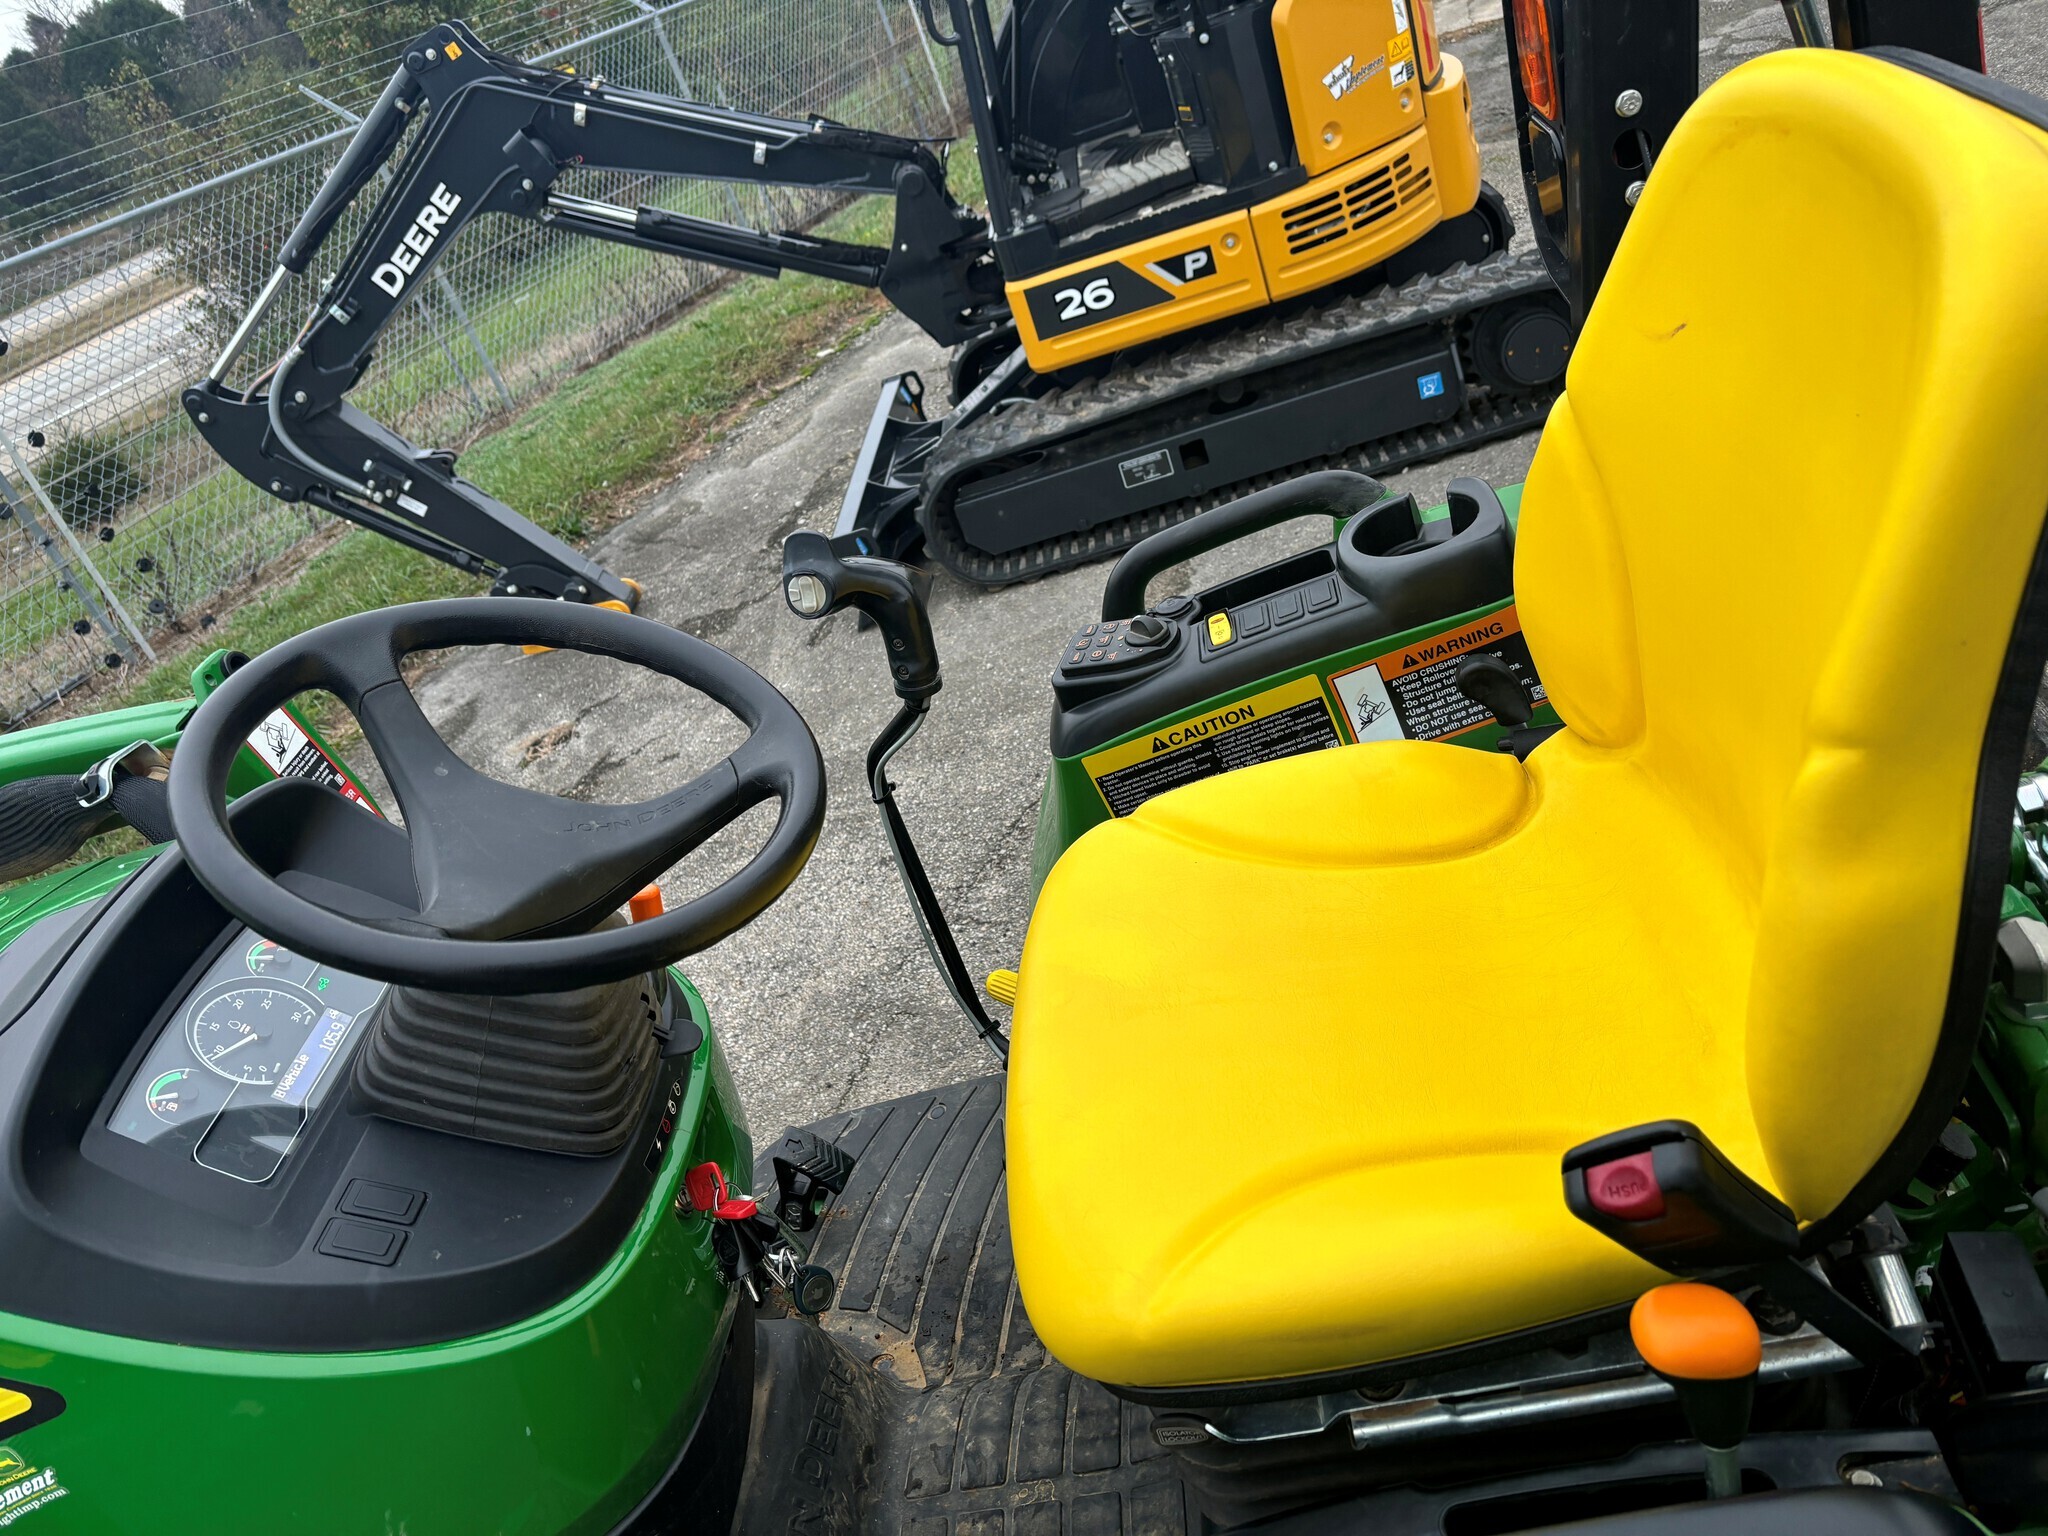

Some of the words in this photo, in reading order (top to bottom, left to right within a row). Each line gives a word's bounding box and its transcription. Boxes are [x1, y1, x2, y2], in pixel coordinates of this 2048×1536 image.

[371, 182, 461, 298] DEERE
[1055, 278, 1115, 321] 26
[1184, 251, 1208, 280] P
[1418, 622, 1504, 662] WARNING
[1390, 672, 1418, 687] AVOID
[1399, 679, 1422, 693] Keep
[1422, 666, 1457, 684] Rollover
[1402, 681, 1442, 700] Structure
[1442, 675, 1457, 686] full
[1405, 698, 1418, 708] Do
[1419, 692, 1434, 703] not
[1434, 684, 1457, 699] jump
[1408, 705, 1425, 716] Use
[1426, 698, 1445, 709] seat
[1169, 705, 1255, 745] CAUTION
[1235, 723, 1252, 733] brakes
[1258, 712, 1282, 725] operating
[1281, 706, 1299, 716] around
[1299, 699, 1319, 709] hazards
[1406, 712, 1431, 726] When
[1431, 698, 1470, 717] structure
[1415, 722, 1429, 732] DO
[1430, 714, 1449, 727] NOT
[1450, 709, 1466, 720] use
[1218, 741, 1236, 751] Couple
[1235, 736, 1250, 745] brake
[1249, 730, 1266, 740] pedals
[1266, 723, 1287, 734] together
[1221, 735, 1236, 744] rough
[1236, 729, 1254, 739] ground
[1260, 721, 1274, 730] steep
[1230, 741, 1250, 753] flashing
[1250, 735, 1270, 746] warning
[1269, 730, 1284, 739] lights
[1291, 720, 1312, 731] highway
[1312, 714, 1329, 723] unless
[1417, 726, 1441, 740] Drive
[1442, 720, 1460, 732] with
[1461, 712, 1483, 725] extra
[1228, 758, 1240, 766] Stop
[1256, 747, 1270, 755] lower
[1270, 738, 1296, 751] implement
[1301, 730, 1320, 740] ground
[1319, 726, 1330, 734] and
[1296, 737, 1318, 749] securely
[1317, 732, 1334, 741] before
[1102, 773, 1115, 781] Read
[1114, 765, 1138, 777] Operator's
[1137, 759, 1154, 768] Manual
[1154, 753, 1170, 762] before
[1169, 746, 1192, 757] operating
[1122, 775, 1140, 786] operate
[1139, 768, 1159, 779] machine
[1159, 762, 1177, 772] without
[1194, 750, 1212, 759] shields
[1117, 784, 1131, 793] safety
[1131, 778, 1149, 787] devices
[1154, 771, 1167, 780] place
[564, 820, 631, 832] JOHN
[637, 778, 713, 824] DEERE
[233, 999, 244, 1010] 20
[261, 999, 272, 1010] 25
[291, 1012, 302, 1022] 30
[209, 1022, 220, 1031] 15
[319, 1023, 345, 1051] 105.9
[214, 1045, 224, 1054] 10
[281, 1054, 309, 1091] Vehicle
[0, 1477, 14, 1485] OHN
[13, 1467, 37, 1480] DEERE
